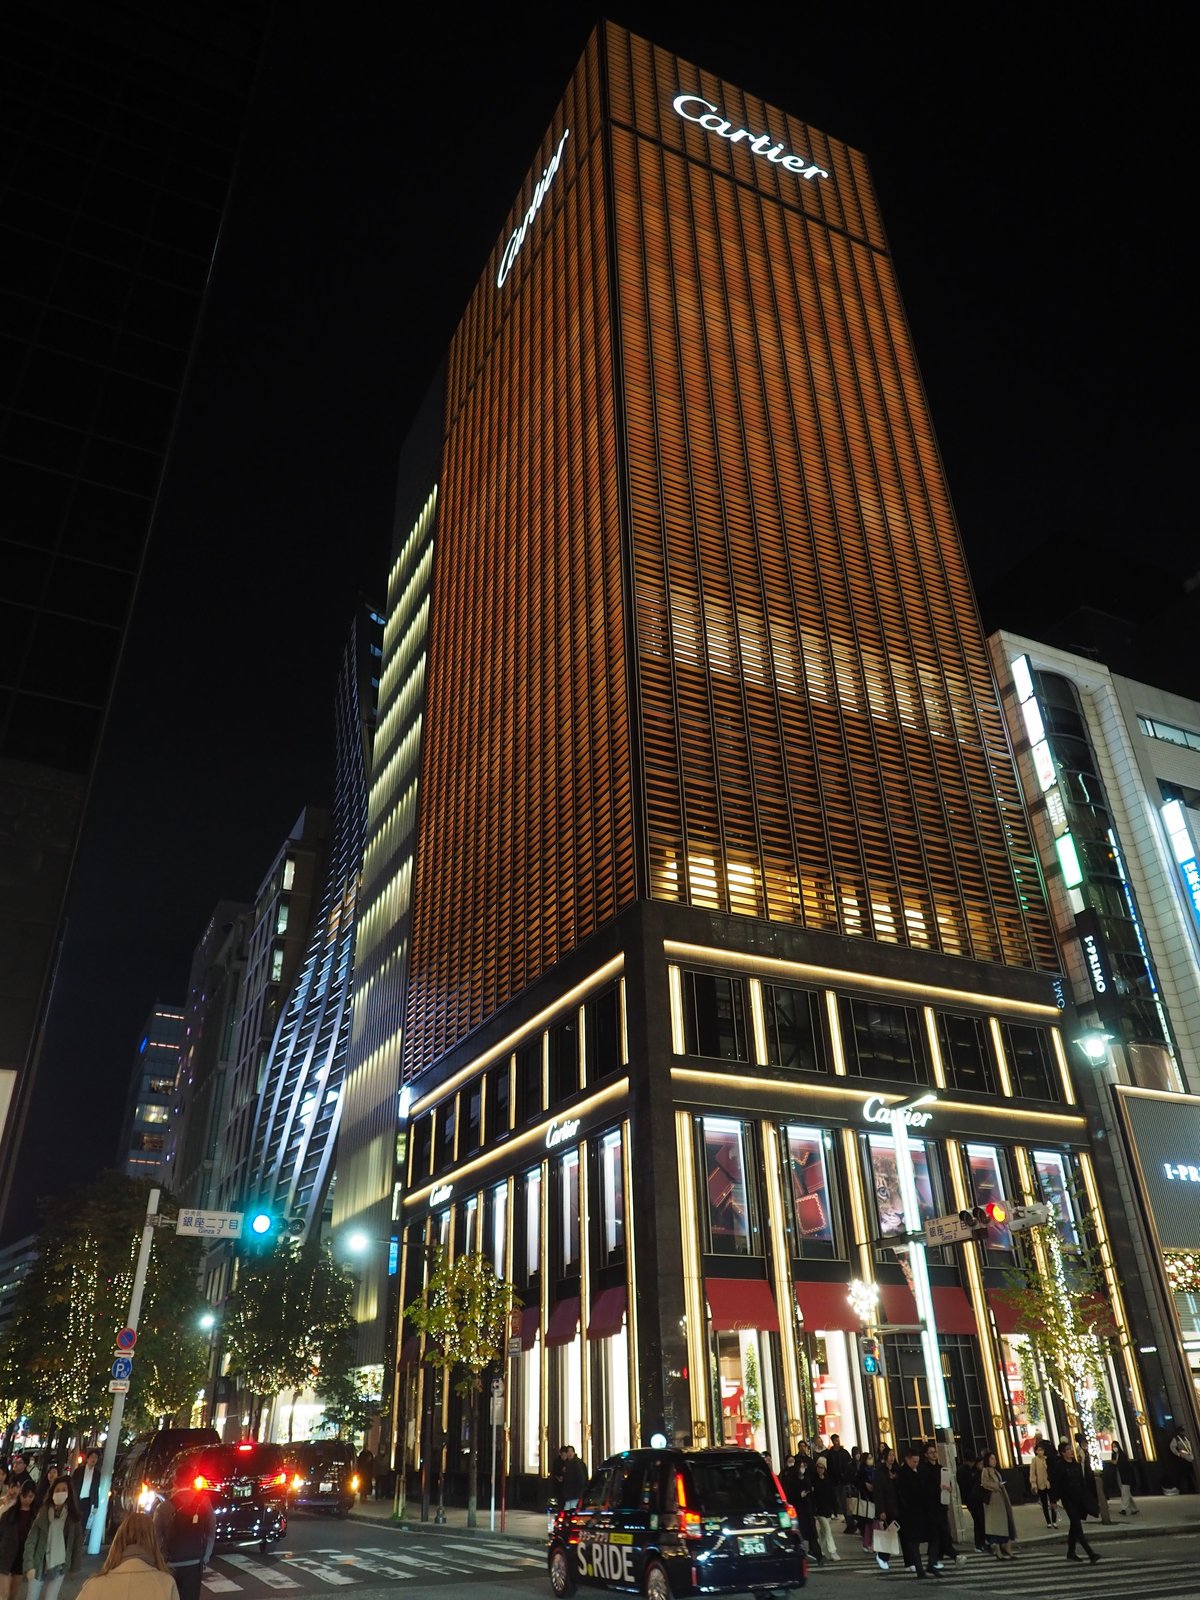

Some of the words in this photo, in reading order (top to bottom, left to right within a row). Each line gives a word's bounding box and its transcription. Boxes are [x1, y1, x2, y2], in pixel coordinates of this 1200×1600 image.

[673, 95, 829, 180] Cartier
[497, 128, 569, 288] Cartier
[1053, 792, 1066, 823] CLINIC
[862, 1095, 933, 1127] Caier
[545, 1119, 581, 1148] Cartier
[1163, 1162, 1200, 1183] I-PR
[429, 1184, 454, 1207] Cartier
[183, 1216, 239, 1230] 銀座二丁目
[115, 1363, 125, 1377] P
[577, 1541, 636, 1583] S.RIDE
